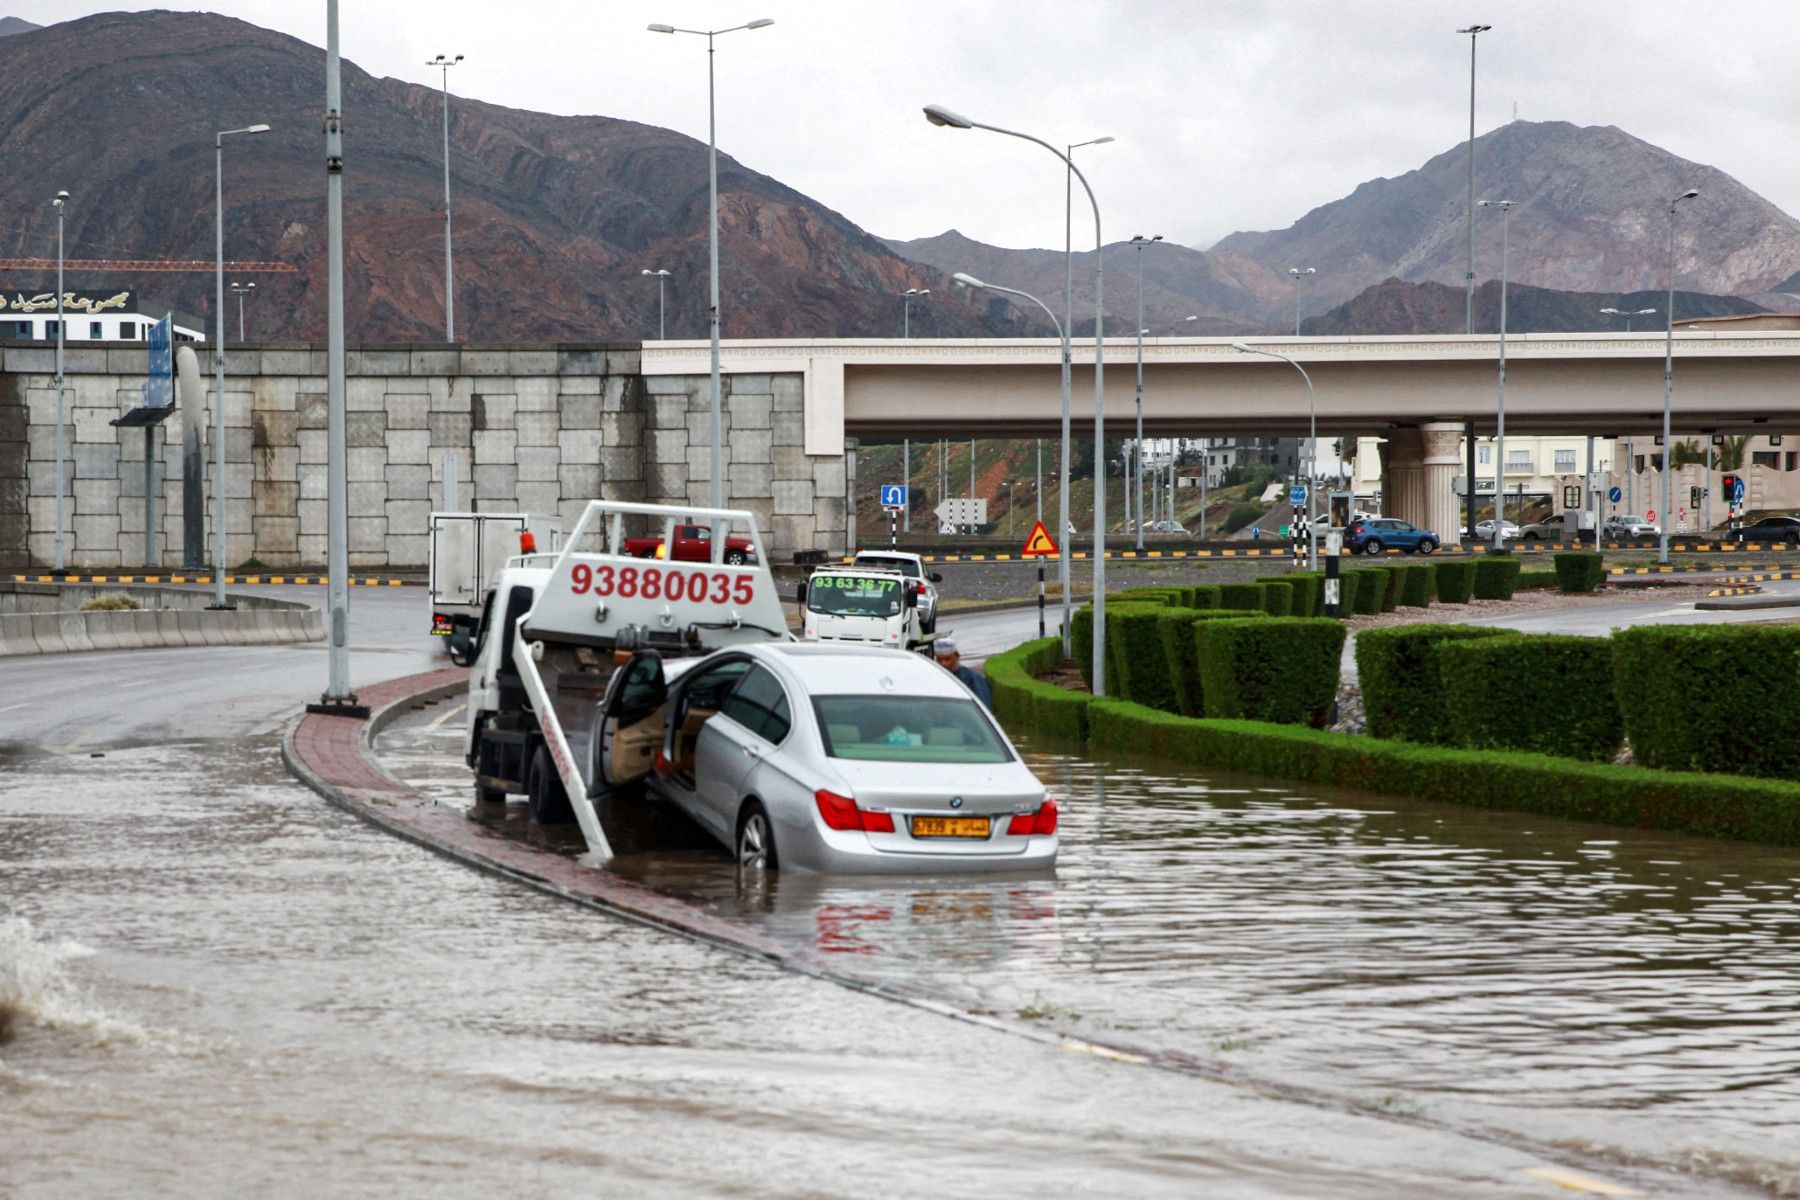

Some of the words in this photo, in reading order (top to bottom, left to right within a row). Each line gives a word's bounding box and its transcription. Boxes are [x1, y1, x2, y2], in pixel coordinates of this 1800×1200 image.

[570, 563, 754, 605] 93880035
[815, 577, 833, 588] 93
[836, 577, 854, 589] 63
[878, 580, 896, 592] 77
